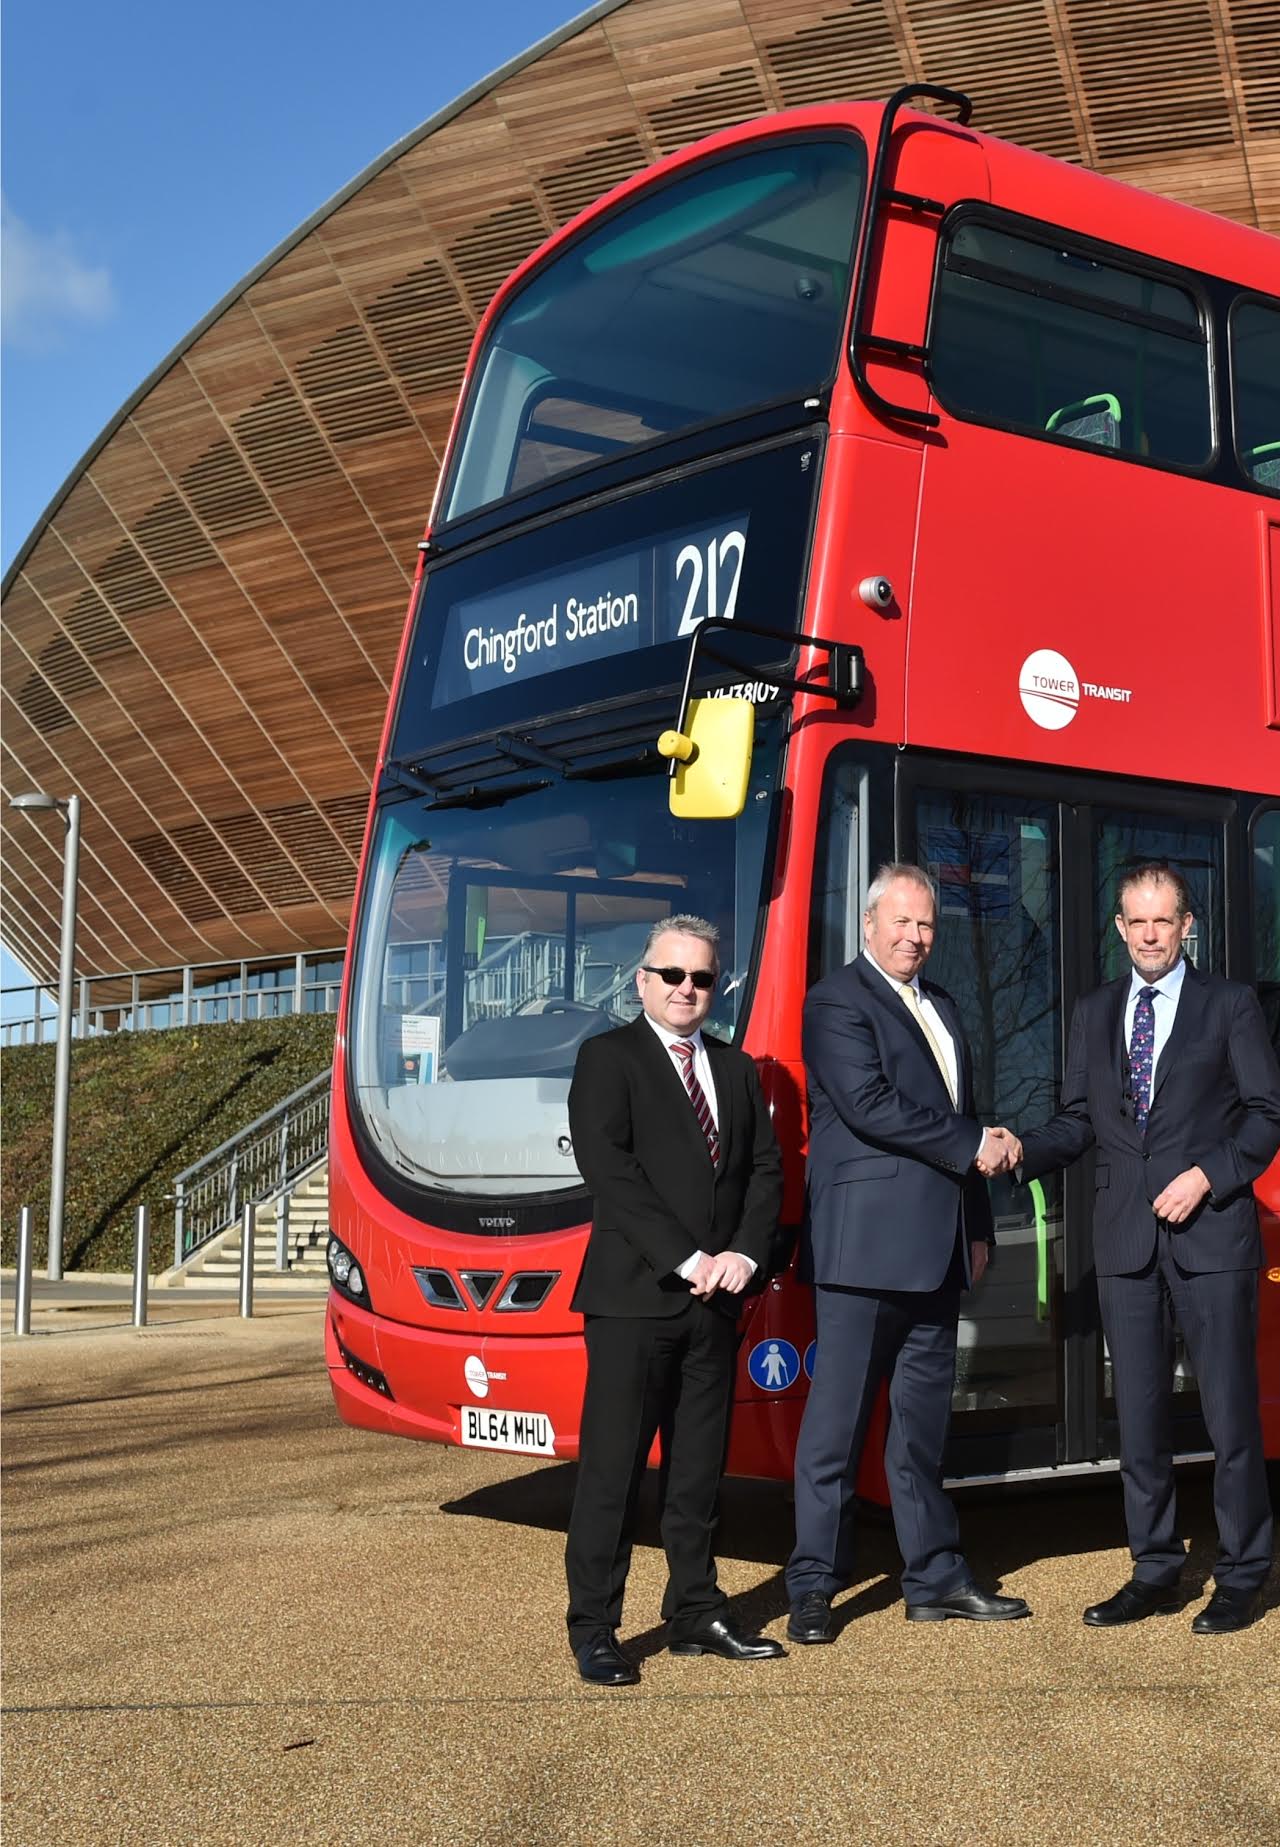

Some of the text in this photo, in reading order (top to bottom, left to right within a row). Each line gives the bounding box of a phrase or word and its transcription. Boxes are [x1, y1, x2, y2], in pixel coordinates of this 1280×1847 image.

[464, 530, 746, 673] Chingford Station 212
[1032, 675, 1132, 703] TOWER TRANSIT
[478, 1217, 515, 1228] VOLVO
[468, 1411, 547, 1447] BL64 MHU
